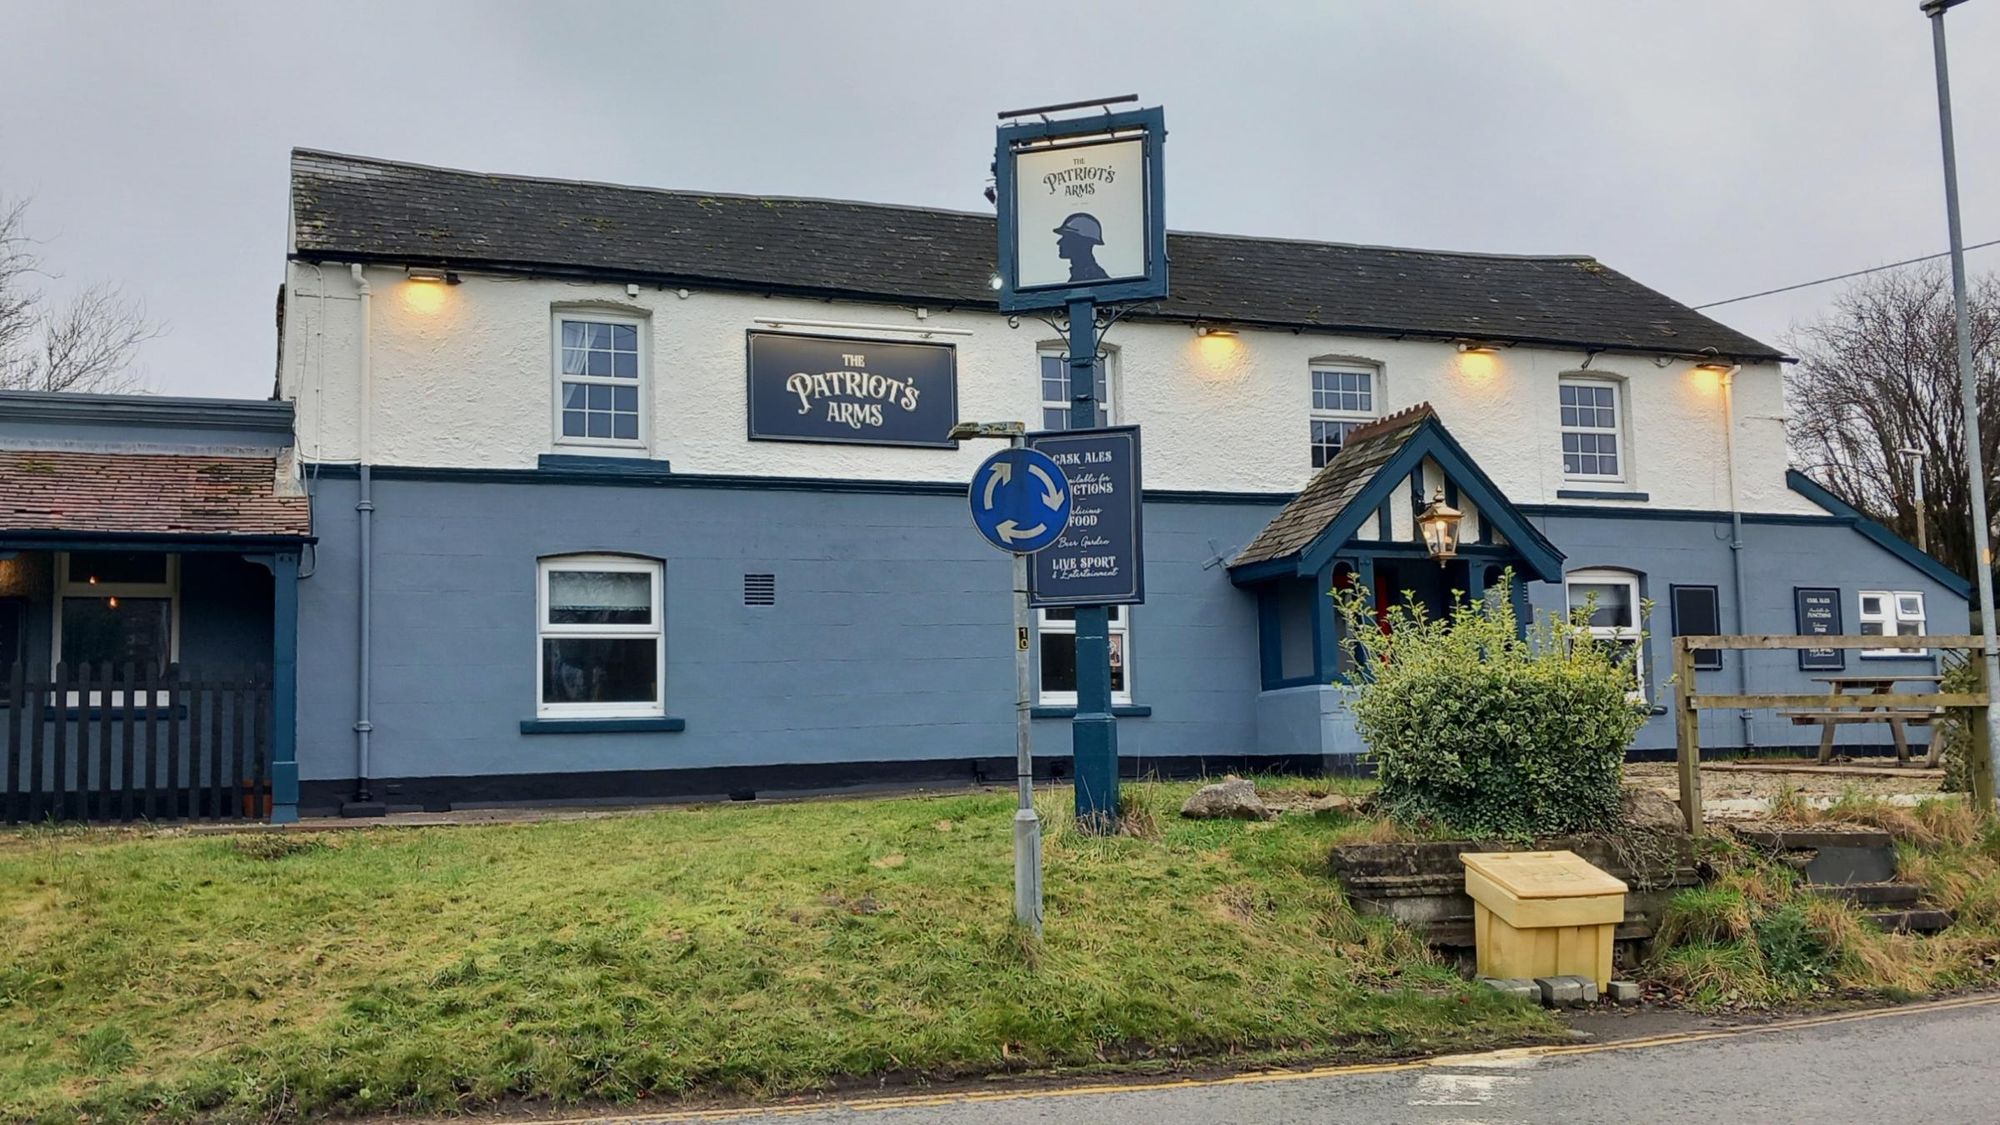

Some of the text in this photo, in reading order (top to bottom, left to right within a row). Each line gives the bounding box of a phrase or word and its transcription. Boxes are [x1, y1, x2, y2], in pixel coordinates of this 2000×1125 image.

[1043, 165, 1116, 195] PATRIOT'S
[1065, 183, 1095, 198] ARMS
[842, 354, 865, 367] THE
[786, 371, 921, 415] PATRIOT'S
[827, 401, 883, 429] ARMS
[1052, 450, 1112, 465] CASK ALES
[1068, 473, 1111, 485] ailable for
[1070, 482, 1113, 495] CTIONS
[1071, 505, 1102, 515] elicious
[1069, 515, 1098, 527] FOOD
[1058, 536, 1110, 549] Beer Garden
[1052, 556, 1116, 570] LIVE SPORT
[1060, 567, 1119, 580] Entertainment
